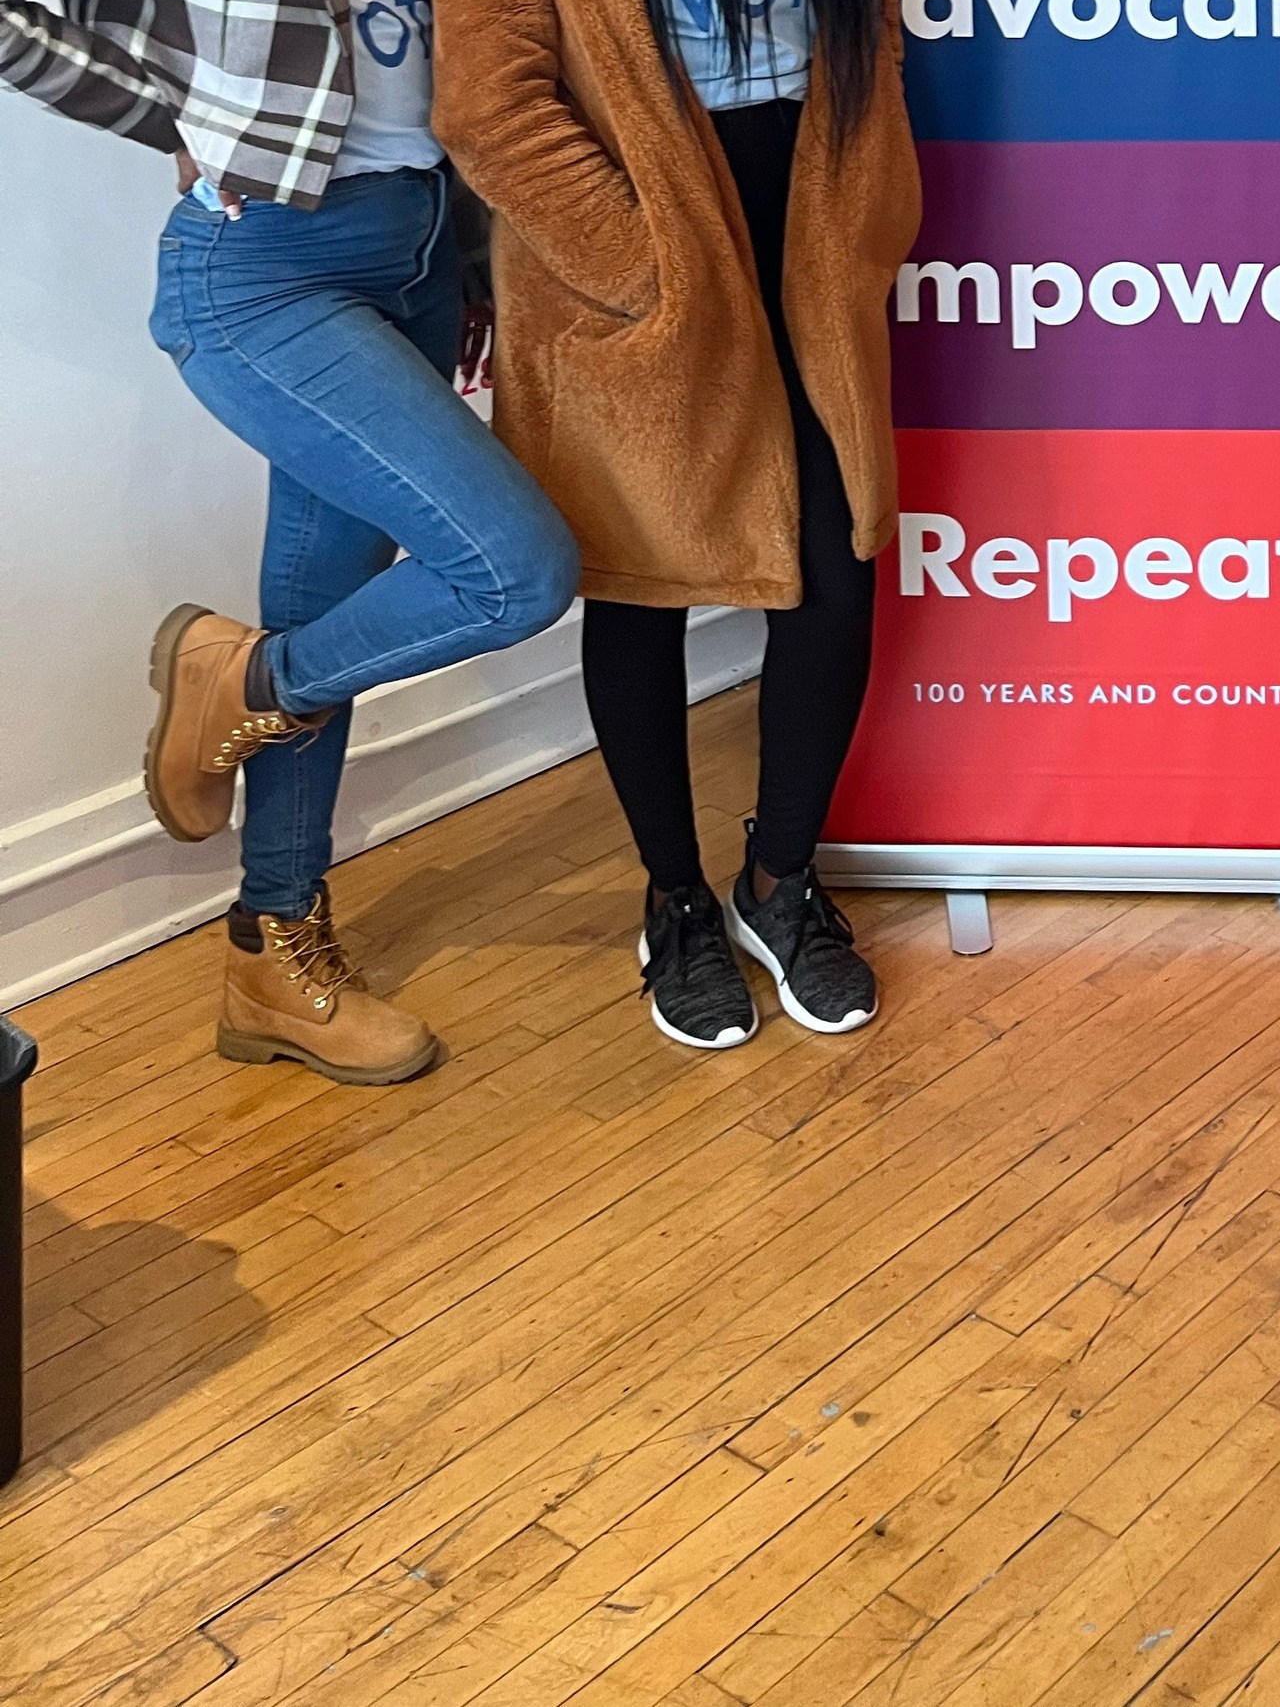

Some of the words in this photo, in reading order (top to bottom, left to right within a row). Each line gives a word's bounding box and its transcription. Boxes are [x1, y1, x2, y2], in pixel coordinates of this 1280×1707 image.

[913, 683, 965, 703] 100
[979, 683, 1074, 704] YEARS
[1088, 684, 1157, 705] AND
